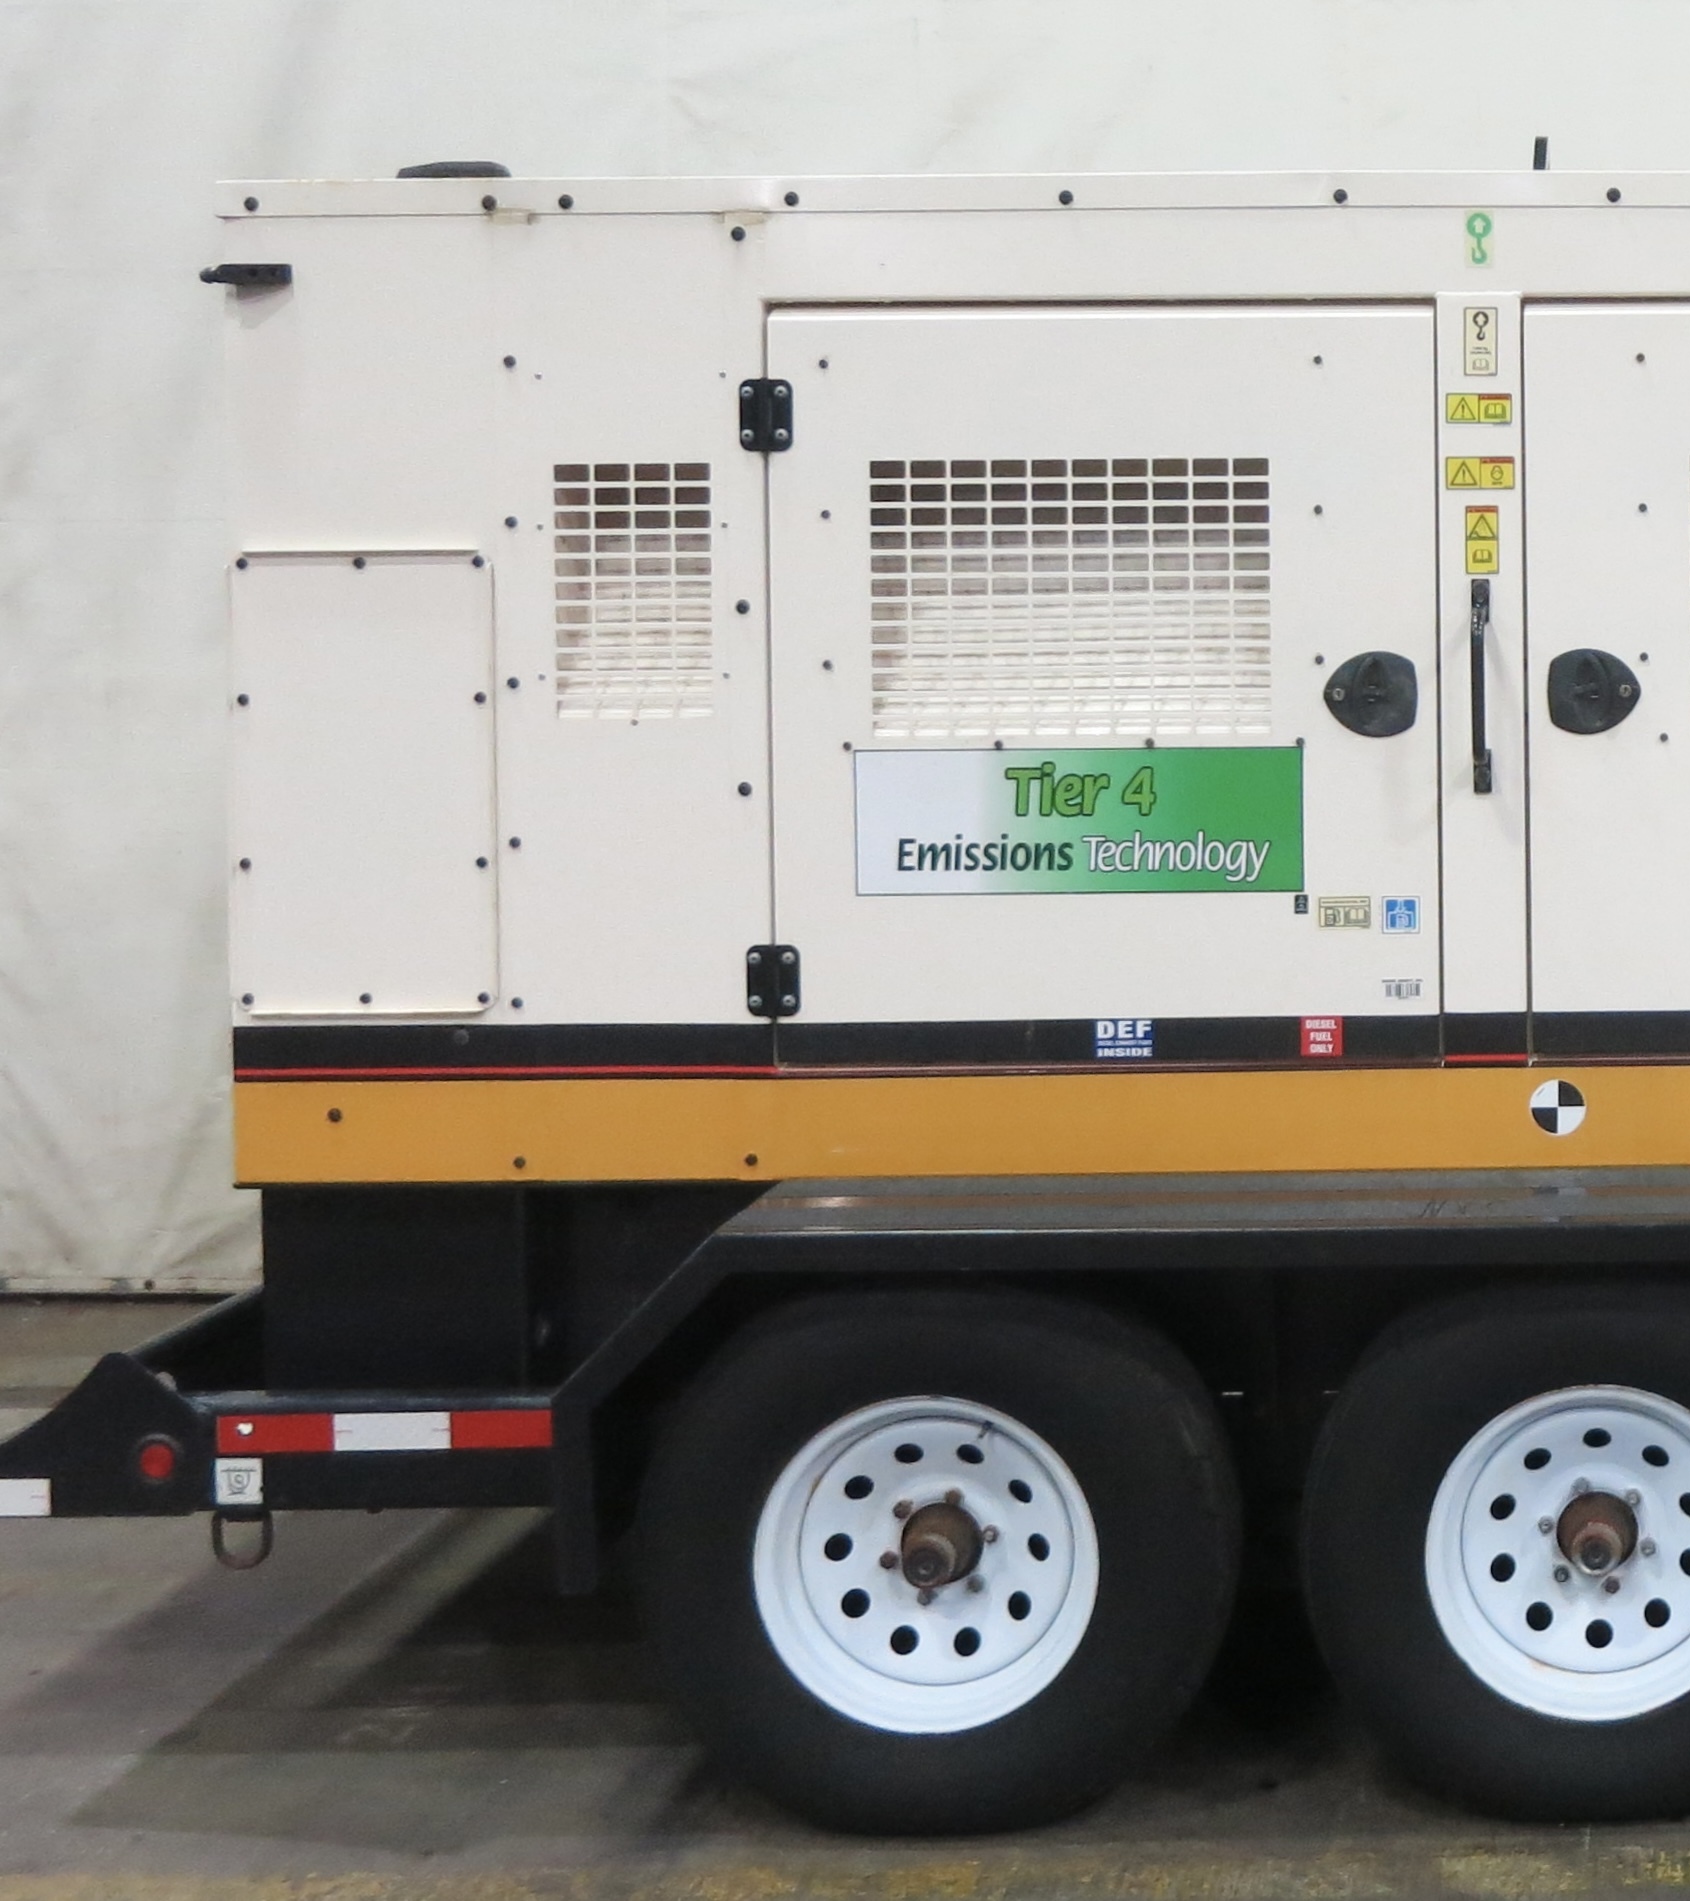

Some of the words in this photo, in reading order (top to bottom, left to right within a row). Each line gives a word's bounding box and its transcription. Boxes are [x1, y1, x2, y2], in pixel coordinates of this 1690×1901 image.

[1005, 762, 1110, 817] Tier
[1121, 766, 1156, 816] 4
[897, 834, 1074, 872] Emissions
[1082, 830, 1271, 882] Technology
[1097, 1020, 1153, 1039] DEF
[1310, 1031, 1333, 1042] FUEL
[1097, 1046, 1154, 1058] INSIDE
